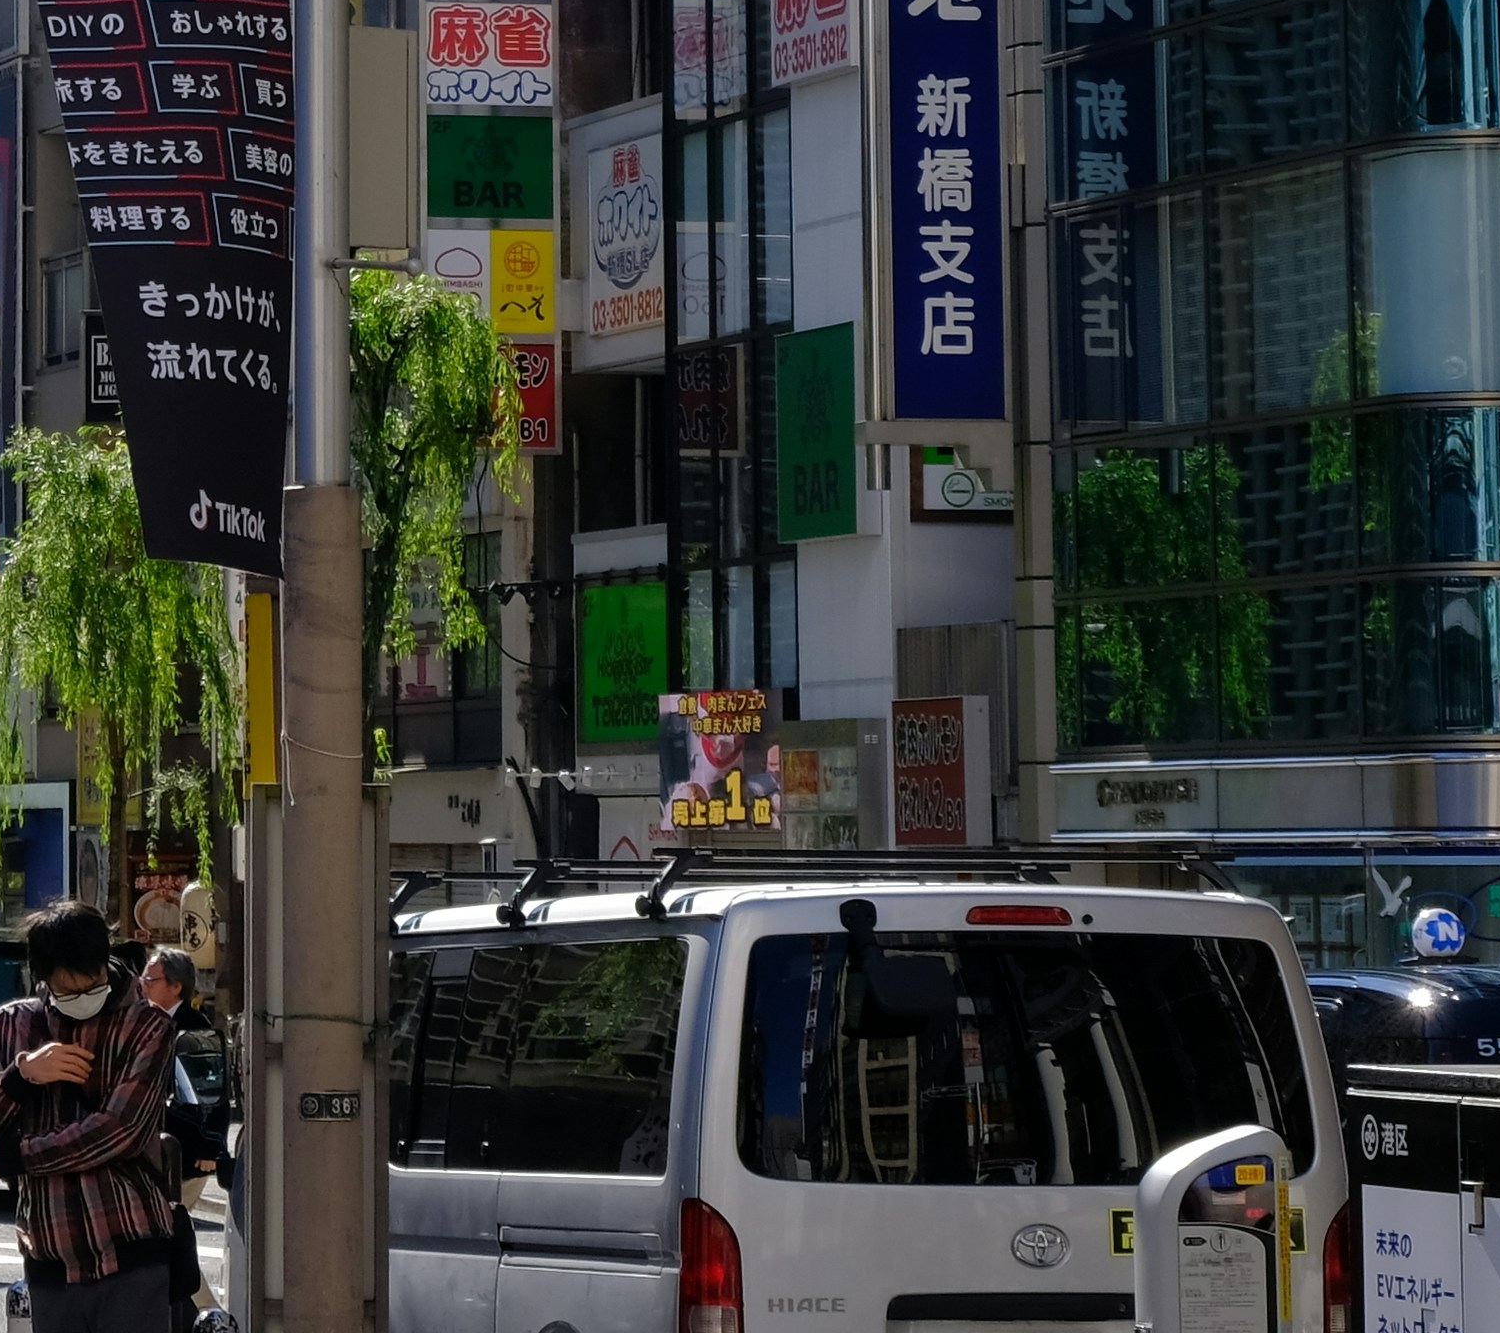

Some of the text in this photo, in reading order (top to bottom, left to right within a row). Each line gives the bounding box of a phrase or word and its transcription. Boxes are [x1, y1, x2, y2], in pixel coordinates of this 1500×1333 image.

[46, 9, 289, 43] DIYの おしゃれする
[427, 3, 552, 69] 麻雀
[171, 73, 222, 100] 学ぶ
[255, 78, 287, 108] 買う
[427, 68, 552, 105] ホワイト
[244, 143, 294, 177] 美容の
[612, 142, 641, 190] 麻雀
[453, 179, 525, 210] BAR
[89, 204, 280, 240] 料理する 役立つ
[597, 182, 660, 247] ホワイト
[916, 73, 976, 358] 新橋支店
[138, 280, 282, 334] きっかけが、
[146, 340, 279, 395] 流れてくる。
[518, 416, 549, 443] B1
[214, 500, 267, 544] TikTok
[693, 714, 762, 735] 中華まん大好き
[1437, 921, 1461, 943] N
[1379, 1121, 1410, 1158] 港区
[1375, 1231, 1413, 1259] 未来の
[766, 1296, 847, 1314] HIACE
[1376, 1273, 1457, 1306] EVエネルギー
